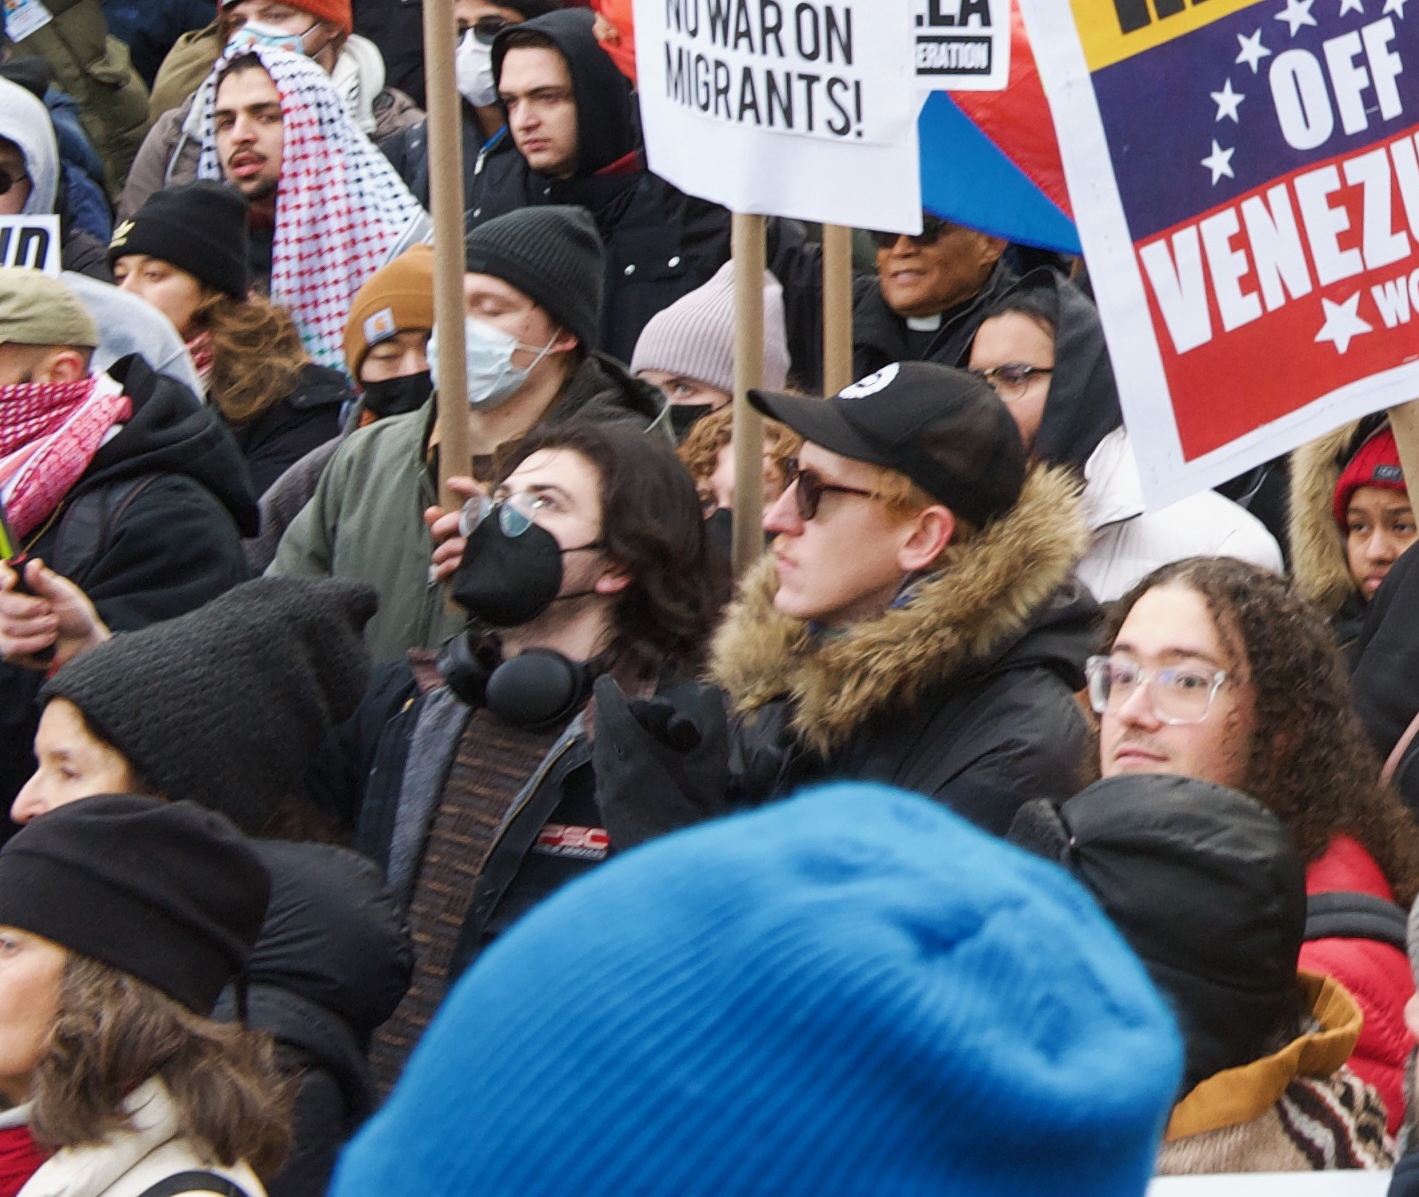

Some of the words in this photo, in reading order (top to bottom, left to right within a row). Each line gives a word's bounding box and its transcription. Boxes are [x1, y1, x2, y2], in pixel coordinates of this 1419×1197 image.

[794, 1, 854, 67] ON
[915, 42, 988, 70] ERATION
[664, 40, 864, 139] MIGRANTS!
[1268, 16, 1404, 151] OFF
